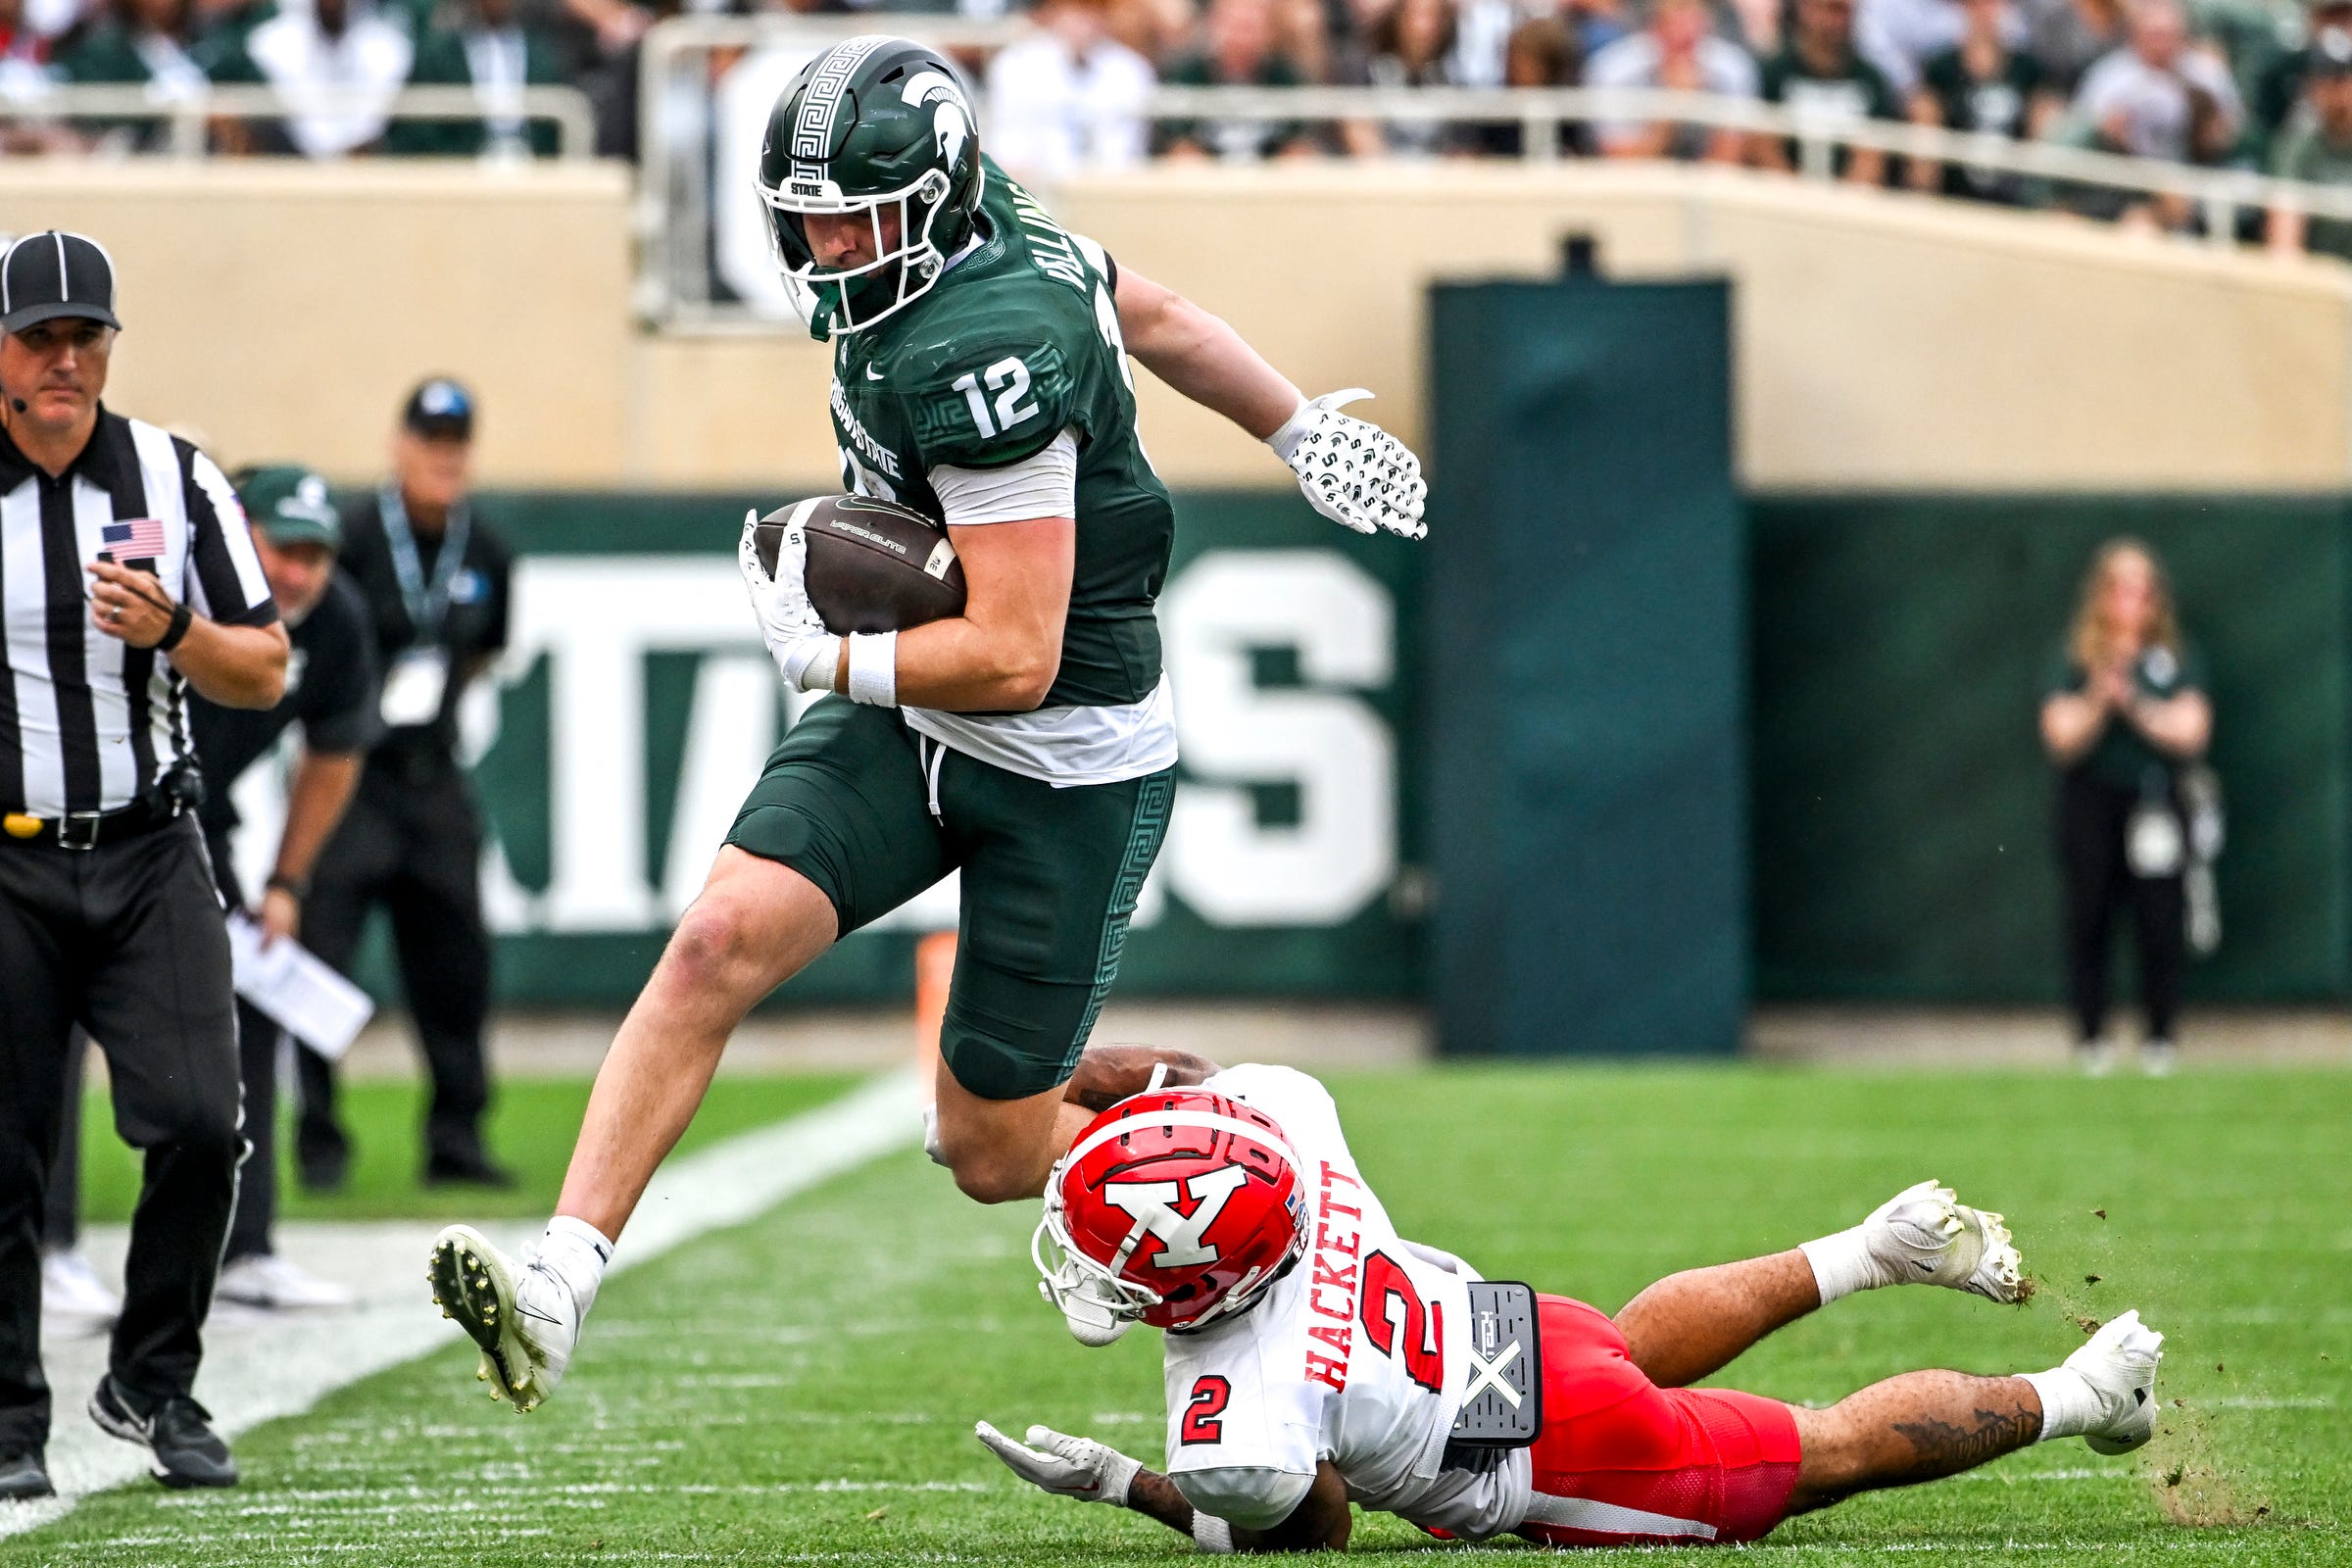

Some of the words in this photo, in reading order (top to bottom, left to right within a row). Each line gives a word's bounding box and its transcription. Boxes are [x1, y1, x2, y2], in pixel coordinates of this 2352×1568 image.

[791, 182, 822, 197] STATE
[951, 356, 1040, 439] 12
[856, 419, 904, 481] STATE
[869, 533, 907, 555] ELITE
[1104, 1164, 1248, 1268] Y
[1304, 1160, 1360, 1395] HACKETT
[1360, 1249, 1443, 1395] 2
[1181, 1374, 1232, 1446] 2
